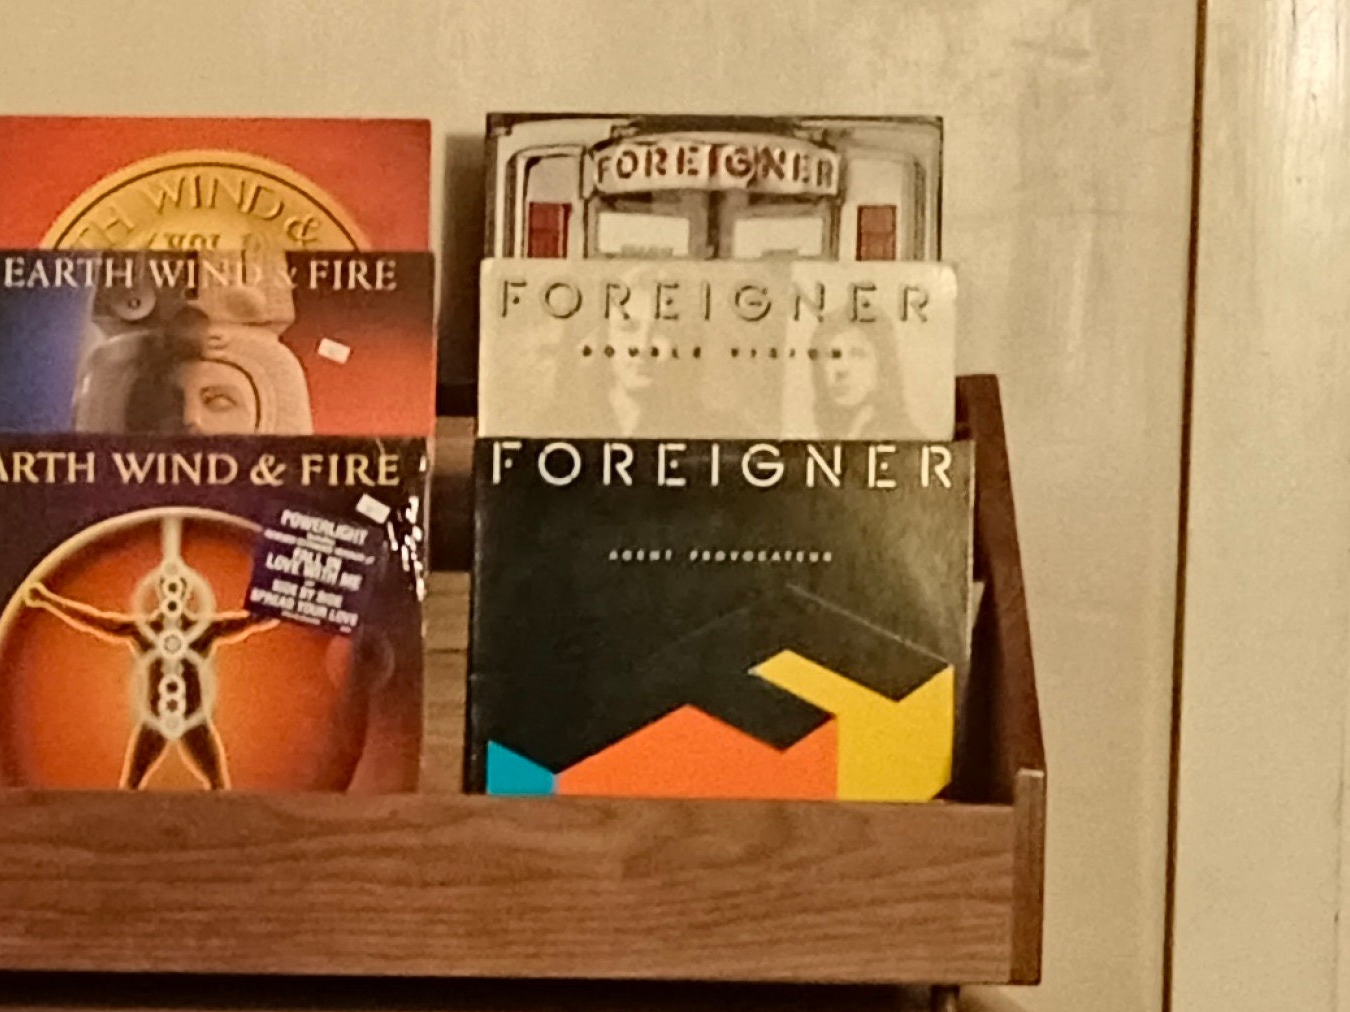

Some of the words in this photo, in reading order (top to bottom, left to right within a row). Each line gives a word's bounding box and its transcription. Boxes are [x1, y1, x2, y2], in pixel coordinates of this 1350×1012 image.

[595, 144, 836, 189] FOREIGNER
[139, 174, 286, 221] WIND
[3, 256, 135, 290] EARTH
[149, 257, 263, 291] WIND
[307, 257, 398, 291] FIRE
[500, 279, 931, 323] FOREIGNER
[115, 451, 239, 487] WIND
[249, 452, 287, 487] &
[301, 452, 400, 489] FIRE
[491, 440, 953, 489] FOREIGNER
